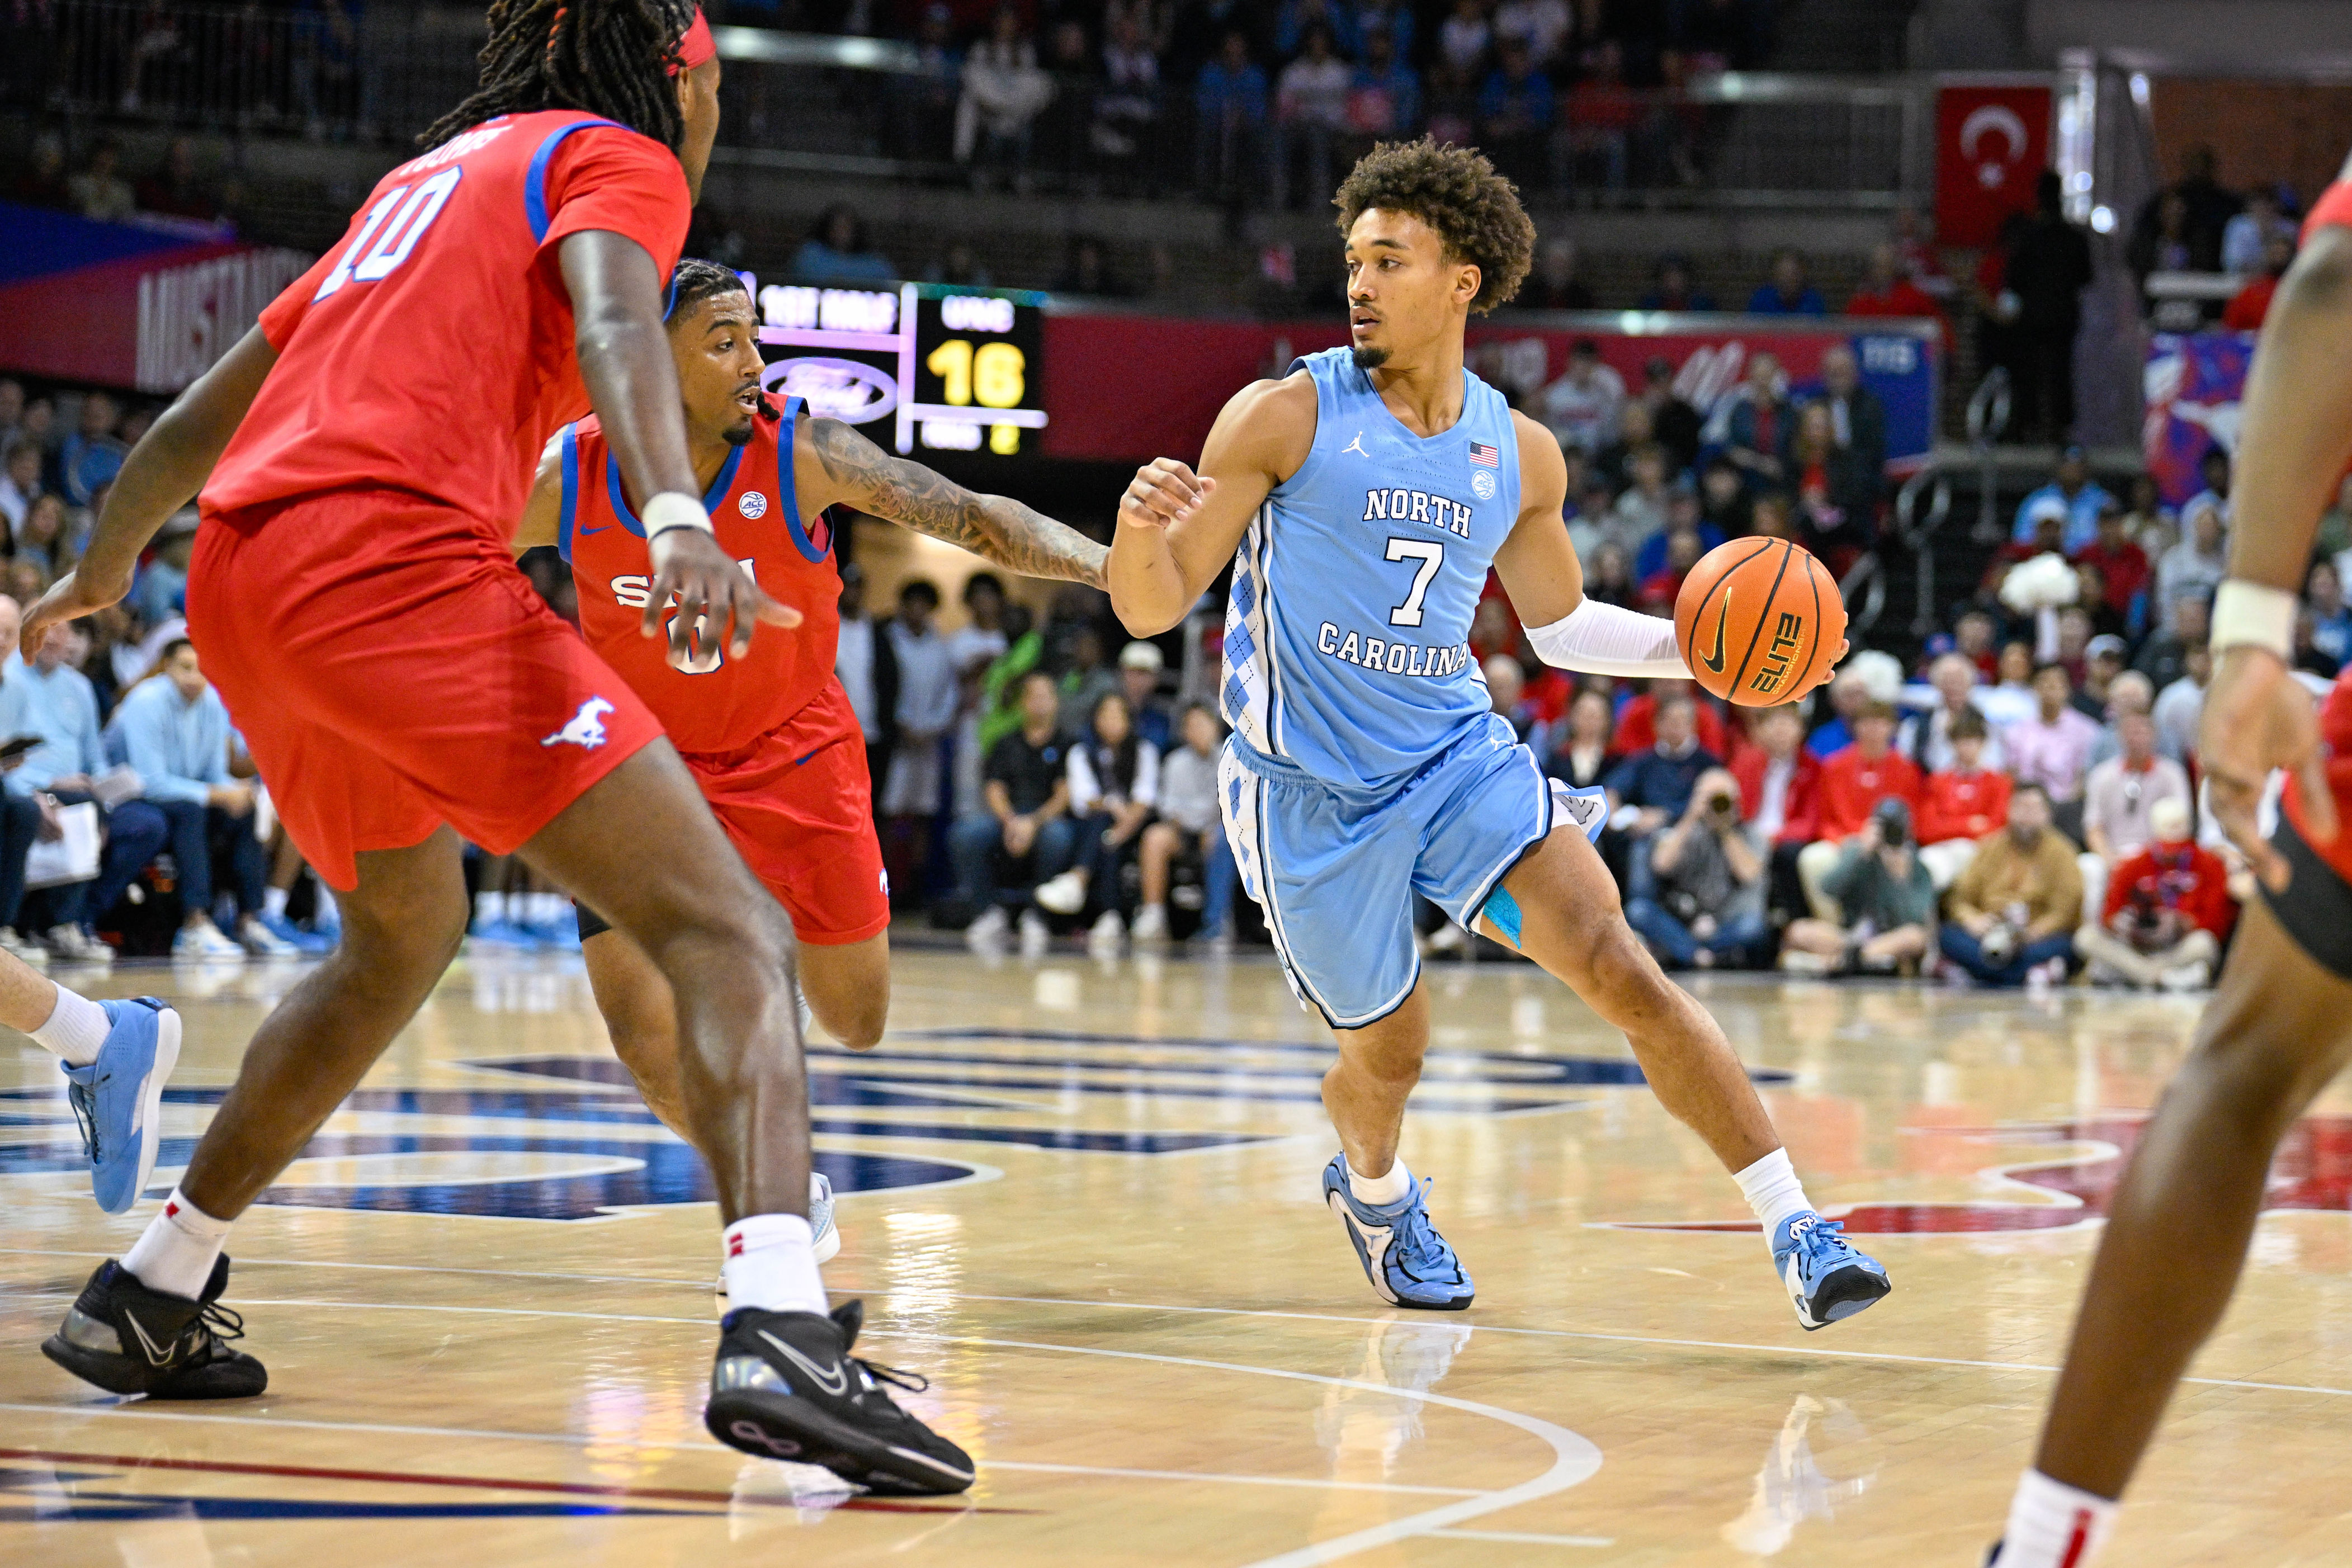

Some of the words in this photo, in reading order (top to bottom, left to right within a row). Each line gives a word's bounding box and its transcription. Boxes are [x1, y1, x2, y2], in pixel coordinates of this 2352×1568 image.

[311, 164, 464, 305] 10
[926, 339, 1026, 409] 16
[743, 499, 764, 509] ACC
[1363, 488, 1472, 539] NORTH
[1476, 480, 1494, 490] ACC
[1383, 536, 1444, 627] 7
[1317, 621, 1469, 677] CAROLINA
[1749, 612, 1802, 693] ELITE
